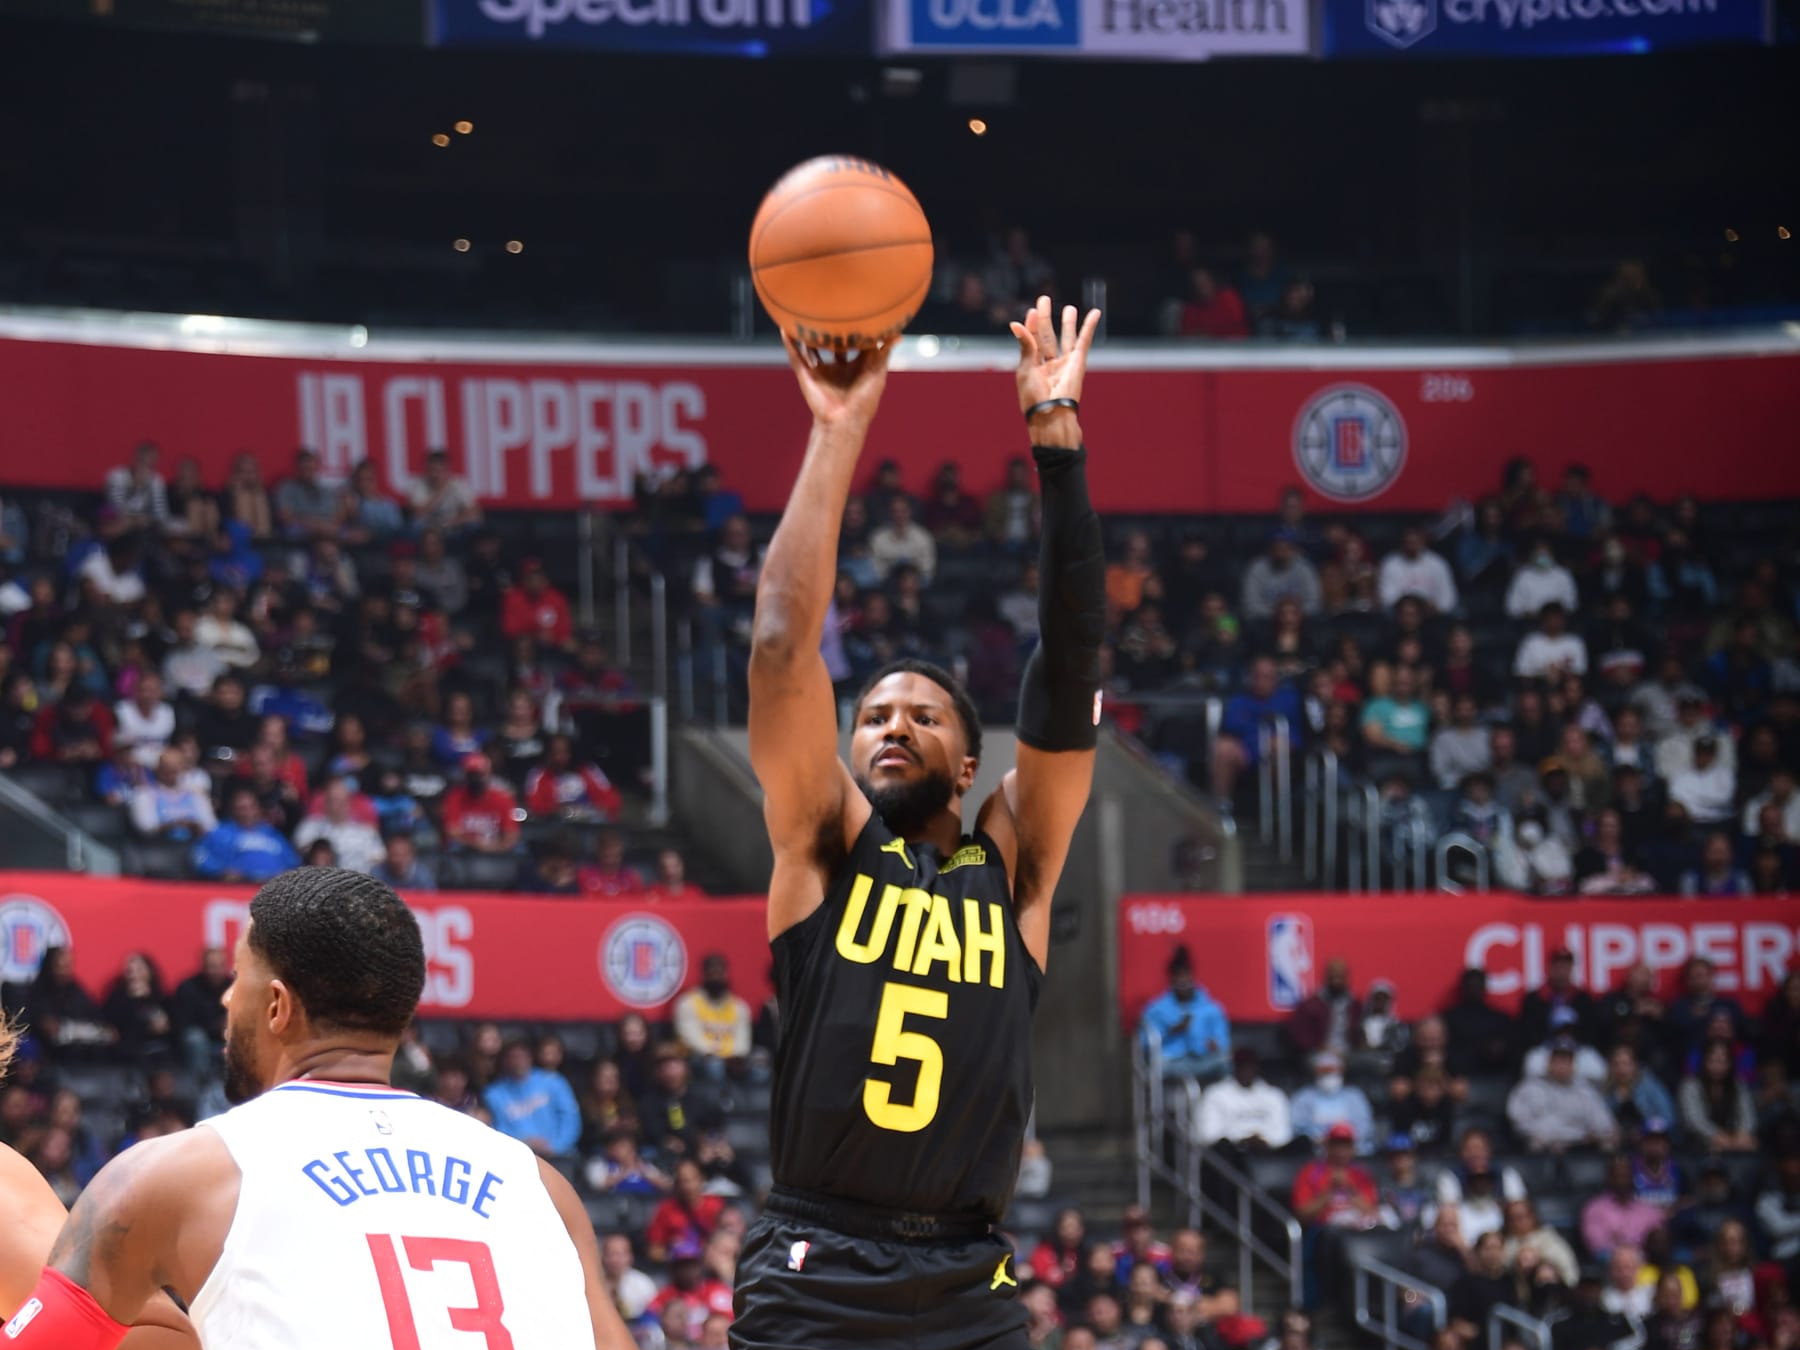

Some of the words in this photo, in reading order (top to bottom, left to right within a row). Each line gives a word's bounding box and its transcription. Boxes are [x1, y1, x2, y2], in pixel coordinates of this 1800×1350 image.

[927, 0, 1062, 29] UCLA
[1100, 0, 1288, 34] Health
[835, 873, 1005, 989] UTAH
[1464, 921, 1800, 994] CLIPPER
[863, 981, 949, 1133] 5
[301, 1148, 504, 1219] GEORGE
